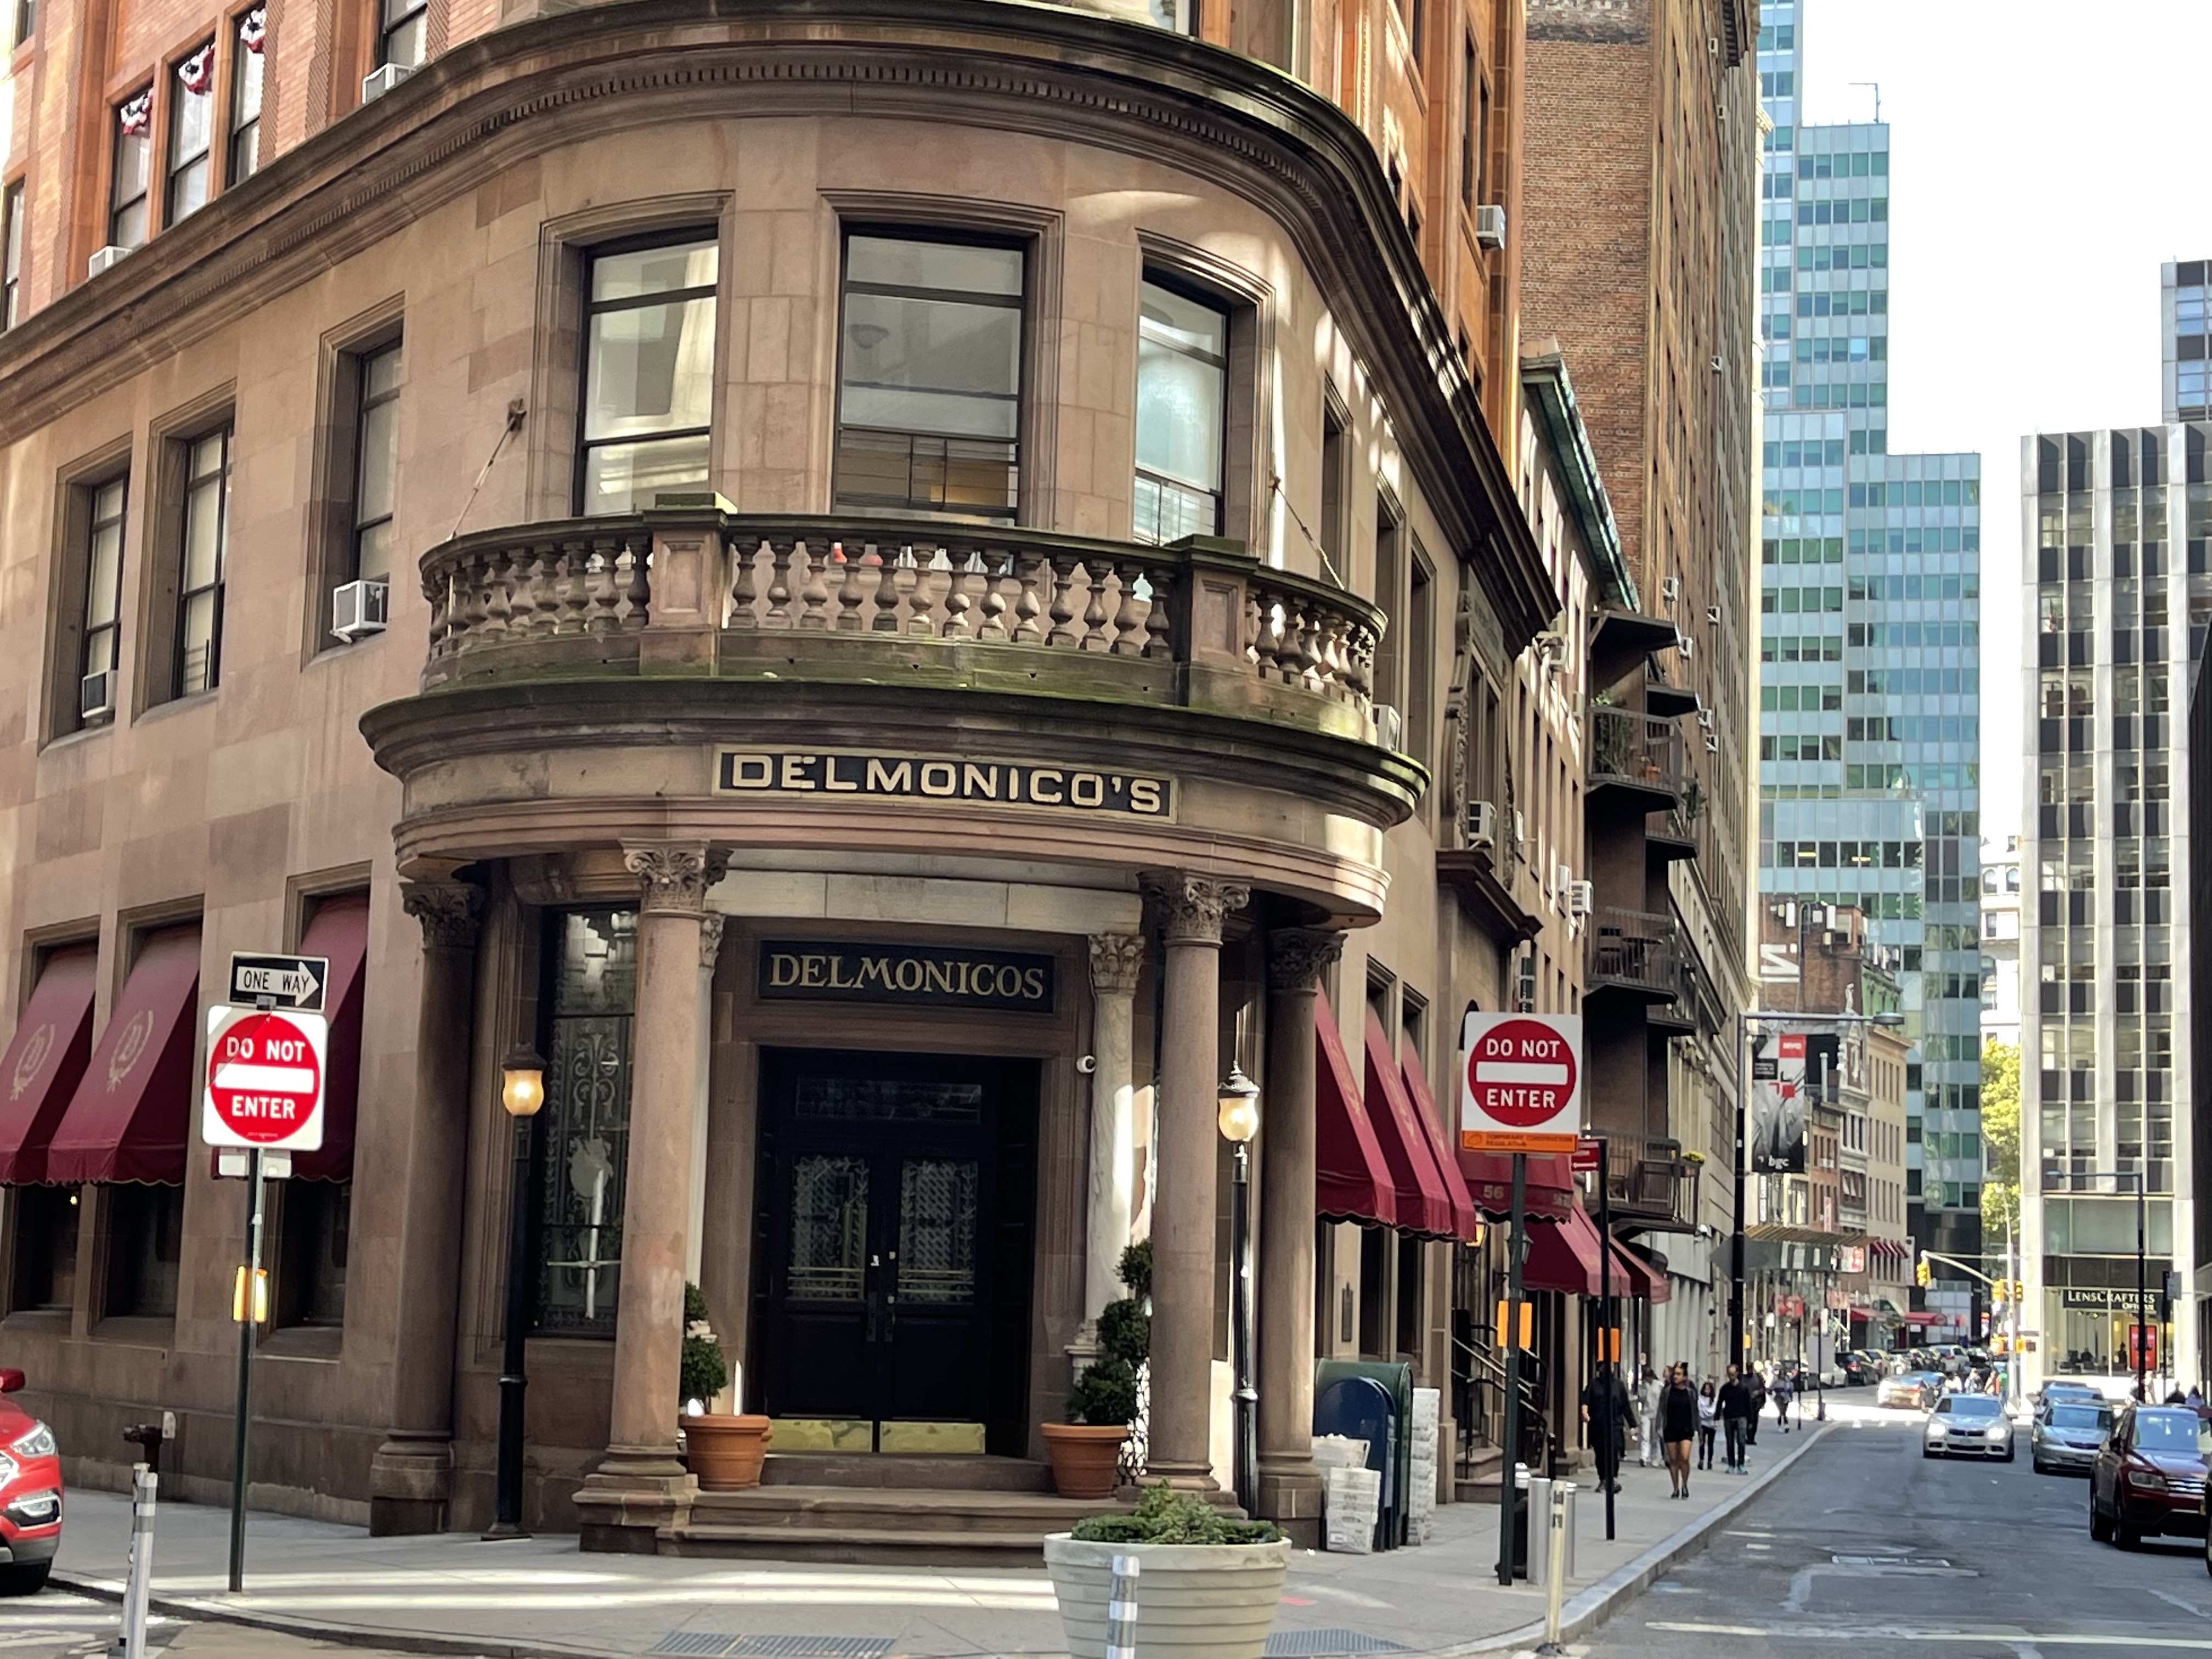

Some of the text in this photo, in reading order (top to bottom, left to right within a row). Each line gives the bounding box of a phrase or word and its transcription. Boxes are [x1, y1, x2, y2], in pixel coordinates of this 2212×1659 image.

[732, 754, 1160, 813] DELMONICO'S
[244, 970, 310, 994] ONE WAY
[769, 953, 1043, 999] DELMONICOS
[226, 1036, 306, 1062] DO NOT
[1486, 1038, 1560, 1058] DO NOT
[231, 1094, 296, 1119] ENTER
[1486, 1088, 1556, 1108] ENTER
[1483, 1184, 1504, 1199] 56
